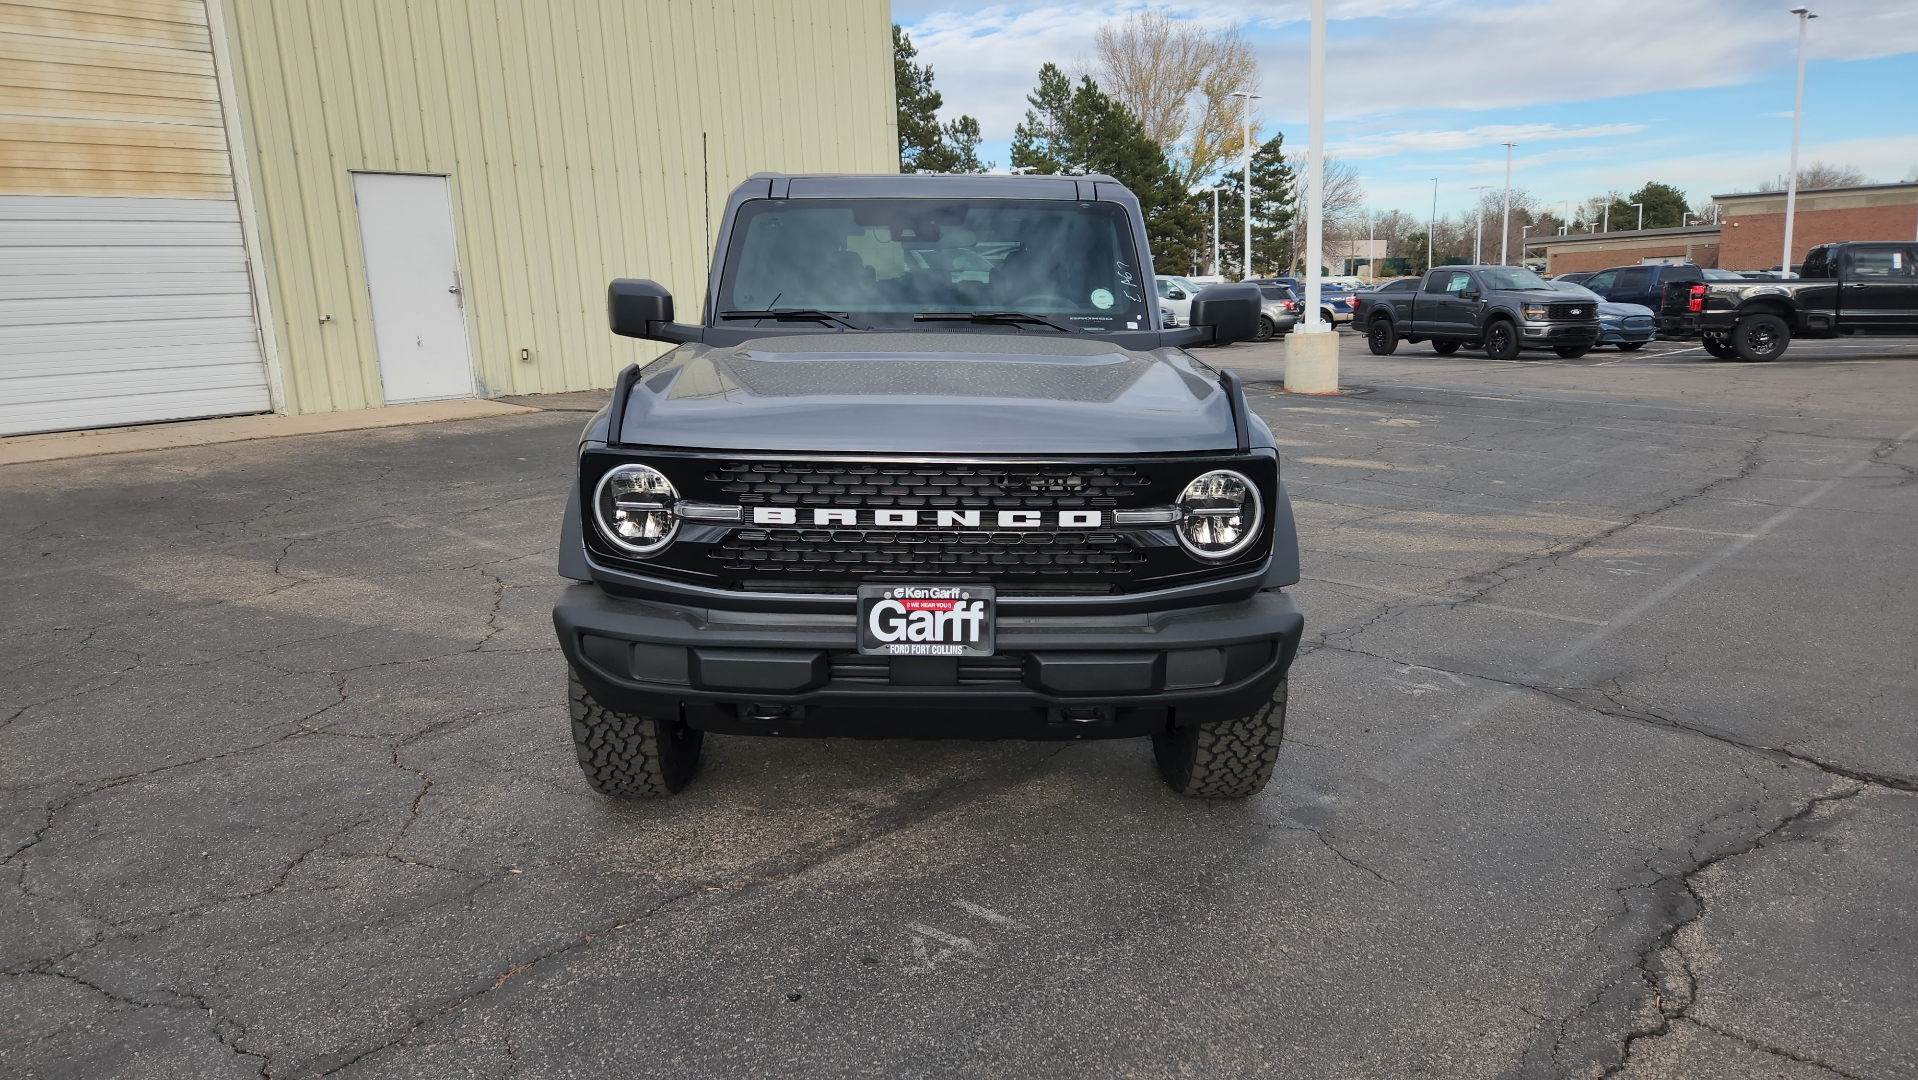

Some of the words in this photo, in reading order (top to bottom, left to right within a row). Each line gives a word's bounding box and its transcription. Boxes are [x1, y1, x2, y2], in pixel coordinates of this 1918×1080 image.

[753, 507, 1102, 528] BRONCO
[905, 587, 929, 599] Ken
[930, 587, 961, 599] Garff
[869, 599, 984, 642] Garff
[890, 644, 910, 654] FORD
[911, 645, 931, 655] FORT
[932, 645, 963, 655] COLLINS
